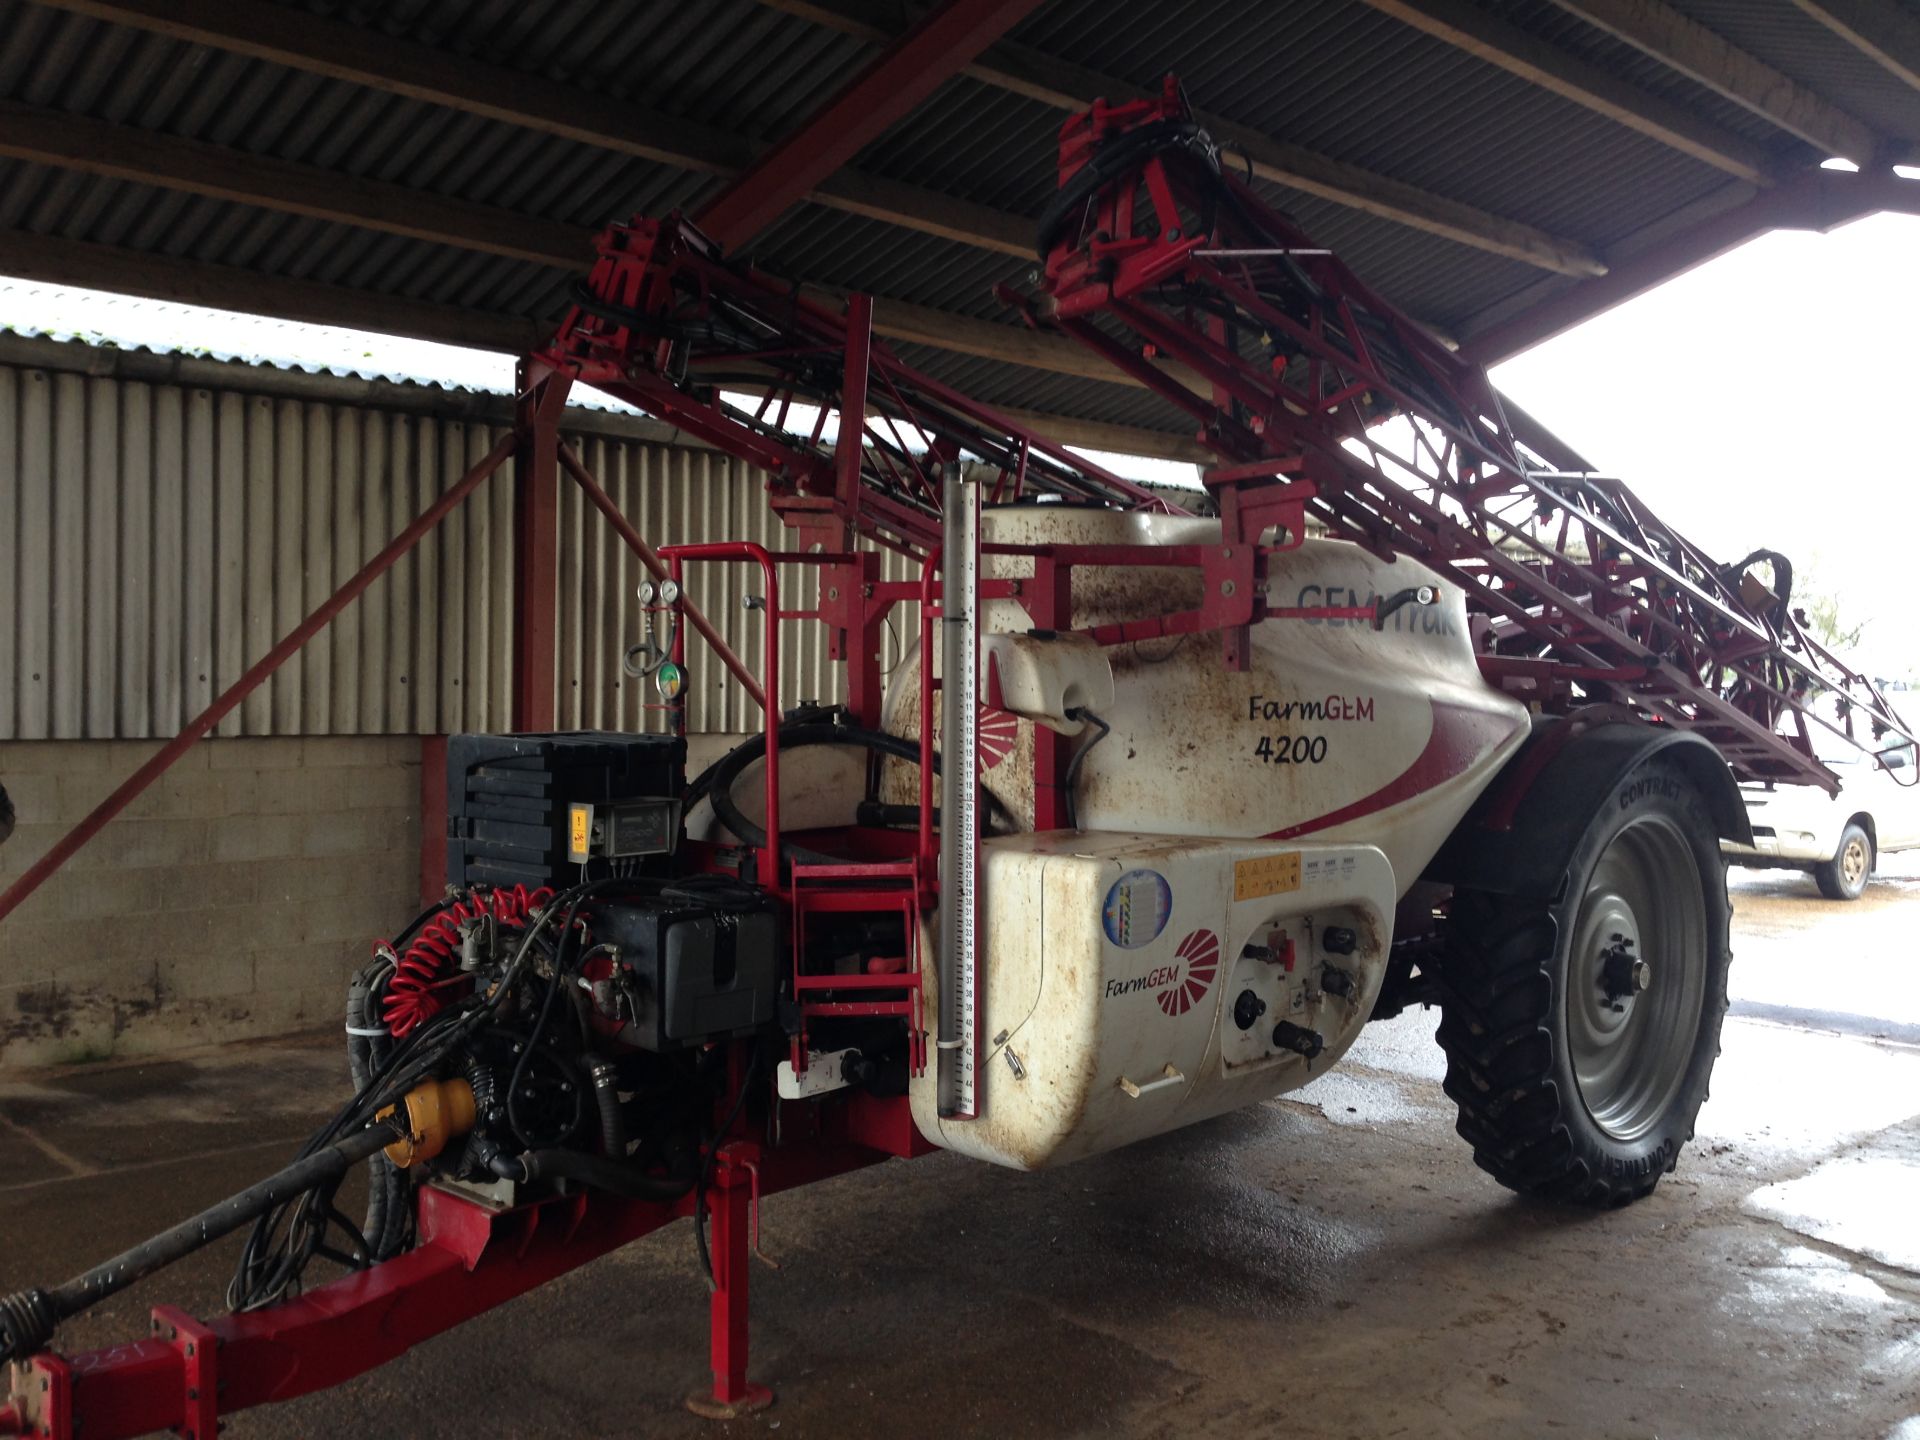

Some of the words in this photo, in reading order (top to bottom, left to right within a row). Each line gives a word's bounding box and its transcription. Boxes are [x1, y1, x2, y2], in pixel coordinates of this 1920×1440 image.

[1249, 695, 1375, 722] FarmGEM
[1254, 736, 1328, 764] 4200
[1620, 776, 1680, 810] CONTRACT
[1105, 964, 1180, 998] FarmGEM
